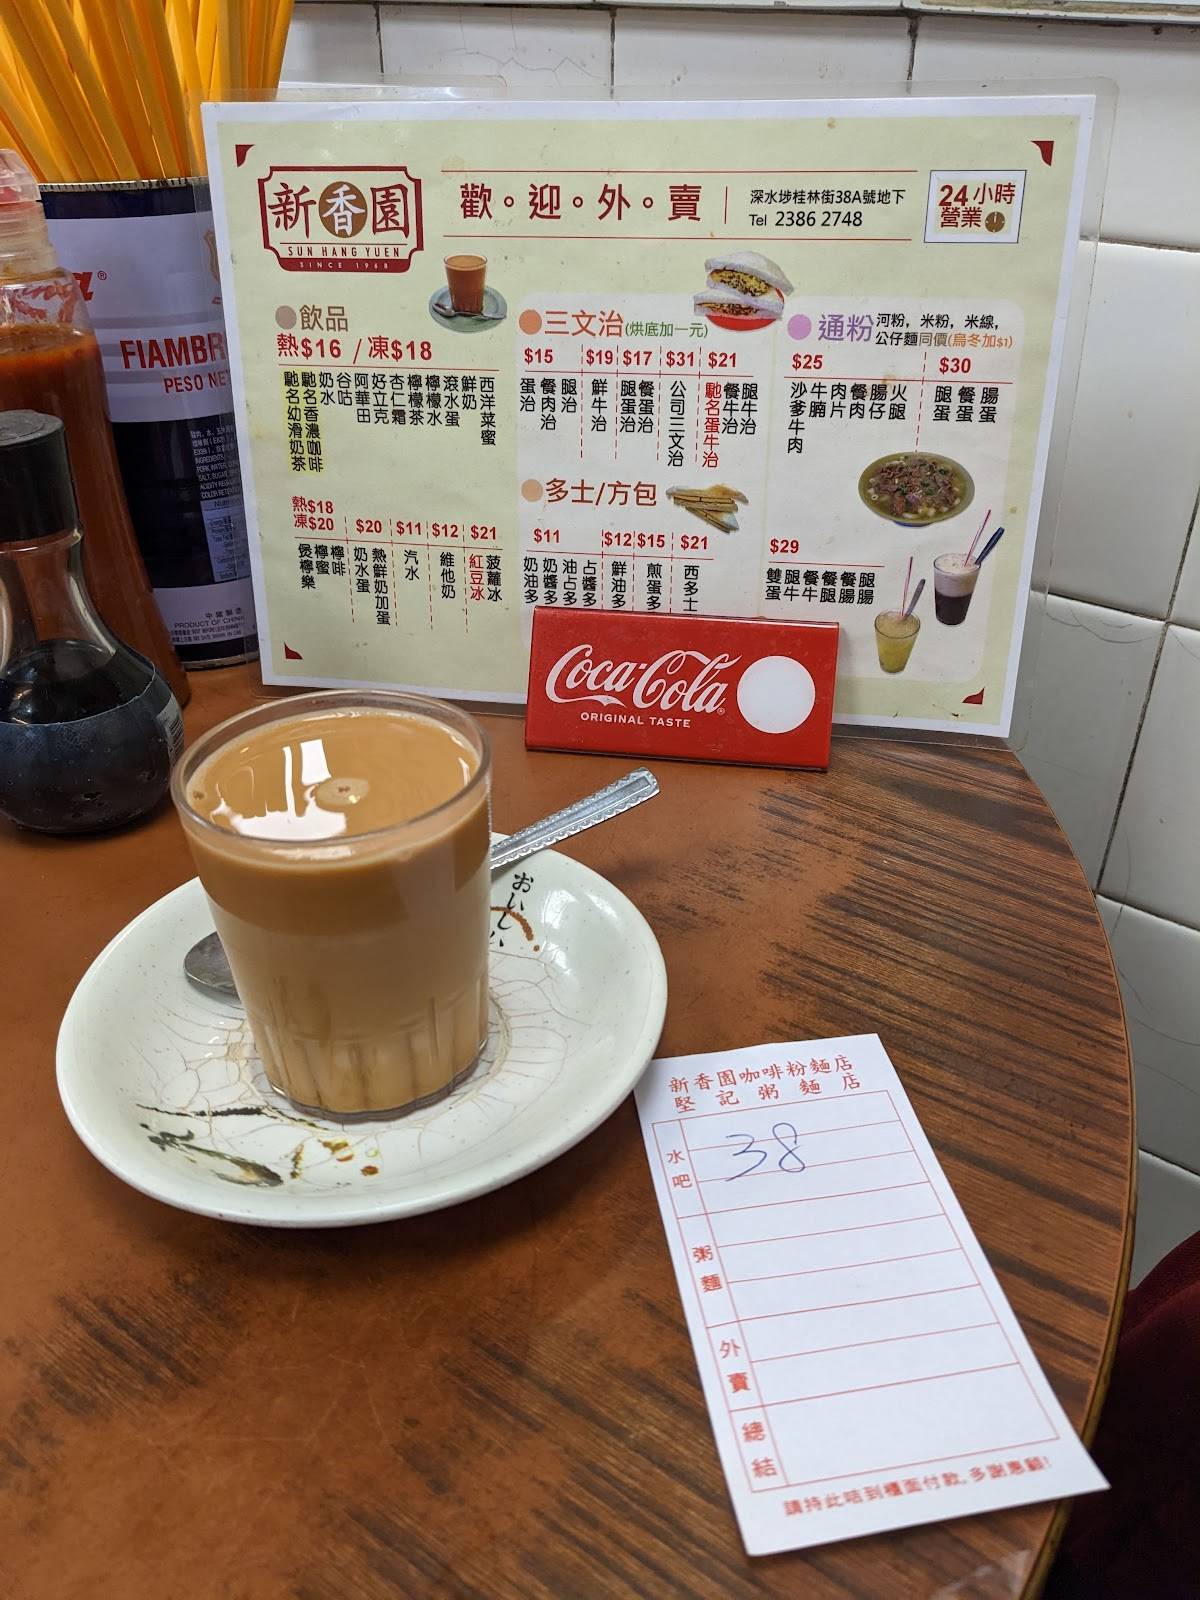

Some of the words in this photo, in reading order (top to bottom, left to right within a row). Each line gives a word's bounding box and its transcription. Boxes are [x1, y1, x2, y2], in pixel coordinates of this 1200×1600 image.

[268, 182, 410, 239] 新香園
[750, 188, 906, 206] 深水埗桂林街38A號地下
[938, 184, 968, 206] 24
[972, 182, 1016, 205] 小時
[749, 214, 767, 227] Tel
[775, 211, 816, 227] 2386
[821, 211, 863, 227] 2748
[940, 206, 983, 228] 營業
[288, 246, 313, 256] SUN
[322, 246, 358, 257] HANG
[365, 247, 400, 258] YUEN
[299, 304, 349, 332] 飲品
[545, 310, 624, 338] 三文治
[625, 321, 709, 338] (烘底加一元)
[818, 313, 875, 342] 通粉
[277, 333, 342, 360] 熱$16
[368, 335, 432, 362] 凍$18
[524, 348, 553, 365] $15
[586, 349, 613, 366] $19
[622, 349, 652, 366] $17
[666, 351, 694, 368] $31
[708, 352, 737, 368] $21
[792, 353, 823, 370] $25
[164, 374, 203, 394] PESO
[208, 369, 231, 389] NE
[939, 357, 971, 374] $30
[319, 371, 336, 406] 奶水
[336, 372, 352, 406] 谷咕
[355, 373, 371, 424] 阿華田
[372, 373, 389, 424] 好立克
[389, 373, 406, 425] 杏仁霜
[407, 374, 424, 426] 檸檬茶
[425, 374, 442, 426] 檸檬水
[443, 375, 460, 427] 滾水蛋
[461, 375, 477, 410] 鮮奶
[520, 378, 535, 413] 蛋治
[541, 378, 557, 431] 餐肉治
[561, 379, 577, 413] 腿治
[591, 379, 608, 432] 鮮牛治
[809, 382, 828, 418] 牛腩
[830, 383, 847, 419] 肉片
[849, 383, 867, 420] 餐肉
[869, 383, 888, 420] 腸仔
[888, 384, 907, 420] 火腿
[933, 386, 951, 422] 腿蛋
[956, 386, 975, 422] 餐蛋
[979, 387, 999, 423] 腸蛋
[284, 371, 307, 472] 馳名幼滑奶茶
[301, 371, 324, 472] 馳名香濃咖啡
[480, 376, 496, 446] 西洋菜蜜
[620, 380, 637, 433] 腿蛋治
[638, 380, 655, 433] 餐蛋治
[668, 380, 686, 467] 公司三文治
[722, 382, 740, 434] 餐牛治
[740, 383, 758, 435] 腿牛治
[787, 382, 807, 454] 沙爹牛肉
[702, 382, 722, 468] 馳名蛋牛治
[292, 496, 334, 514] 熱$18
[545, 478, 657, 507] 多士/方包
[294, 513, 334, 531] 凍$20
[356, 519, 382, 534] $20
[396, 521, 422, 536] $11
[432, 523, 458, 538] $12
[470, 525, 497, 540] $21
[534, 528, 560, 544] $11
[604, 532, 631, 547] $12
[637, 532, 665, 548] $15
[681, 535, 708, 550] $21
[770, 539, 799, 554] $29
[314, 544, 330, 575] 檸蜜
[330, 545, 346, 576] 檸啡
[353, 547, 370, 593] 奶水蛋
[404, 550, 419, 580] 汽水
[440, 552, 456, 599] 維他奶
[469, 554, 485, 600] 紅豆冰
[372, 548, 390, 625] 熱鮮奶加蛋
[486, 555, 502, 602] 菠蘿冰
[523, 557, 539, 604] 奶油多
[542, 558, 558, 605] 奶醬多
[562, 559, 577, 606] 油占多
[582, 560, 597, 607] 占醬多
[611, 560, 627, 609] 鮮油多
[647, 563, 662, 611] 煎蛋多
[683, 565, 700, 612] 西多士
[765, 568, 782, 600] 雙蛋
[783, 569, 800, 602] 腿牛
[802, 570, 819, 603] 餐牛
[820, 571, 838, 603] 餐腿
[838, 571, 856, 604] 餐腸
[857, 572, 875, 605] 腿腸
[174, 621, 210, 629] PRODUCT
[545, 644, 743, 715] Coca-Cola
[581, 711, 644, 725] ORIGINAL
[649, 717, 691, 728] TASTE
[668, 1054, 853, 1094] 新香園咖啡粉麵店
[667, 1149, 693, 1189] 水吧
[725, 1122, 805, 1182] 38
[719, 1338, 751, 1393] 外賣
[741, 1421, 778, 1479] 總結
